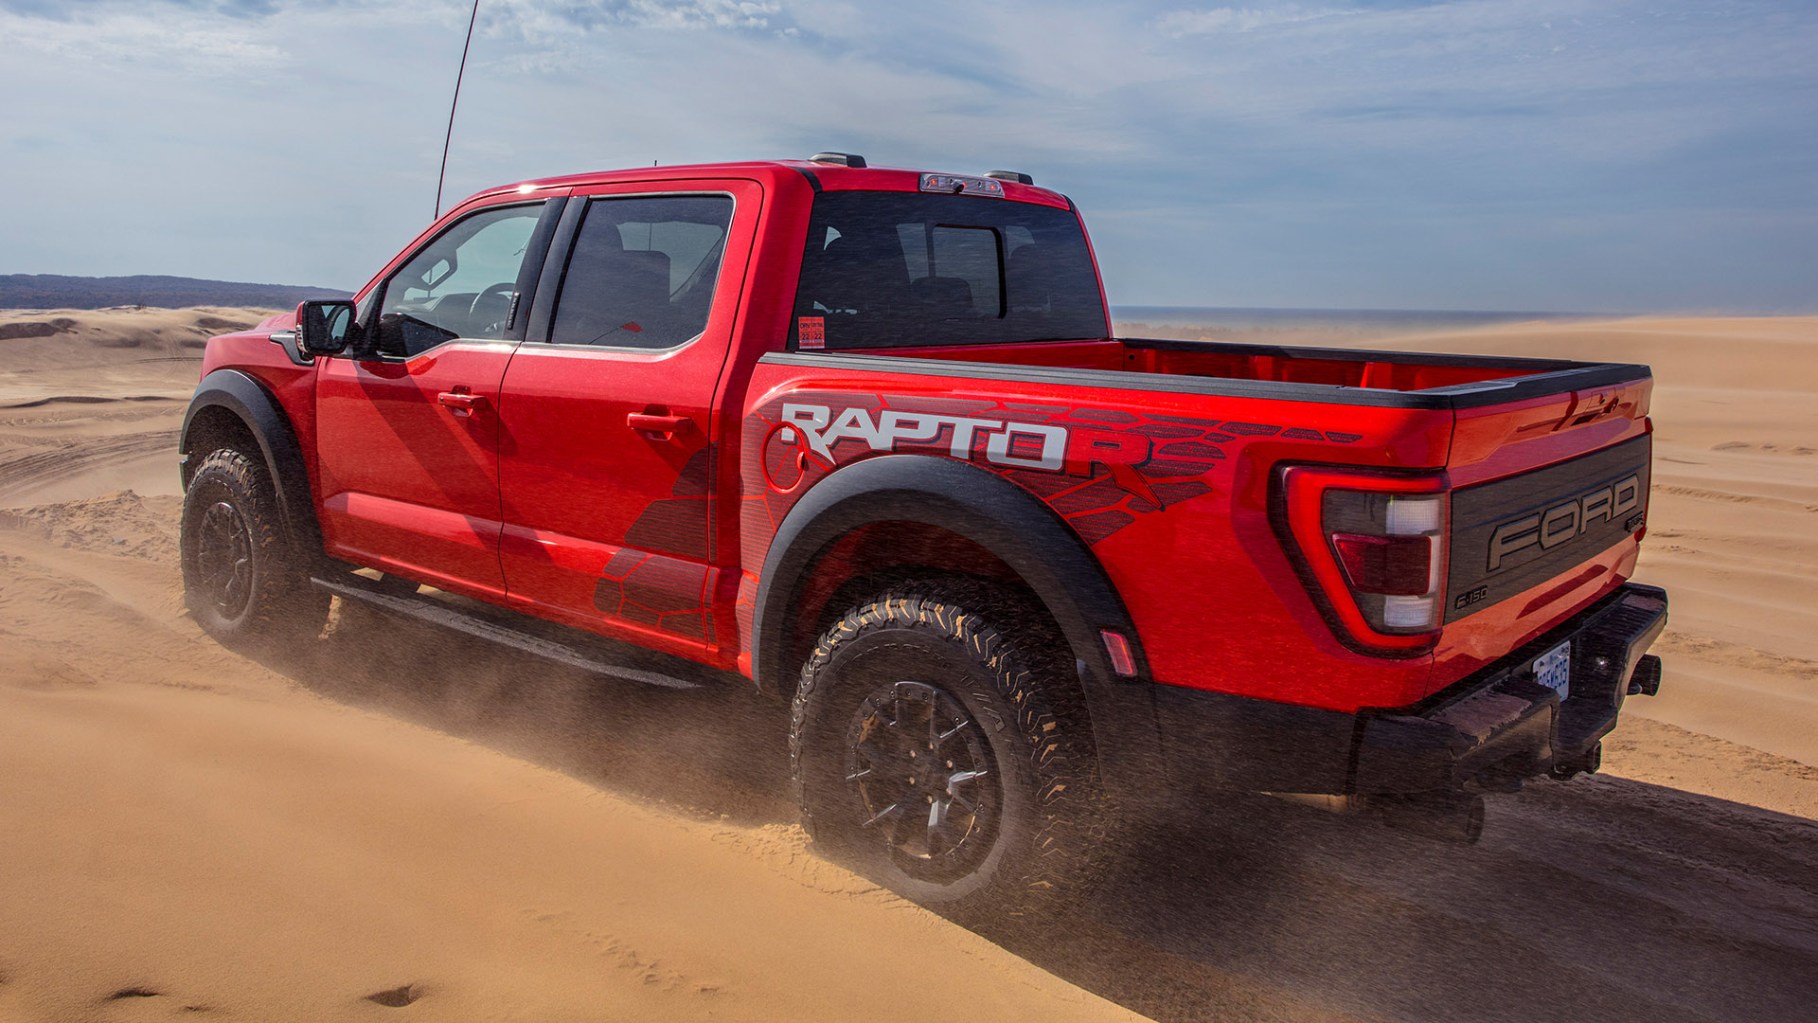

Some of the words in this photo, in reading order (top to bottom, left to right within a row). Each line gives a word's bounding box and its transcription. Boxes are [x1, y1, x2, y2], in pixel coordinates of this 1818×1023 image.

[781, 402, 1165, 510] RAPTOR
[1488, 474, 1641, 572] FORD
[1455, 586, 1488, 610] F-150
